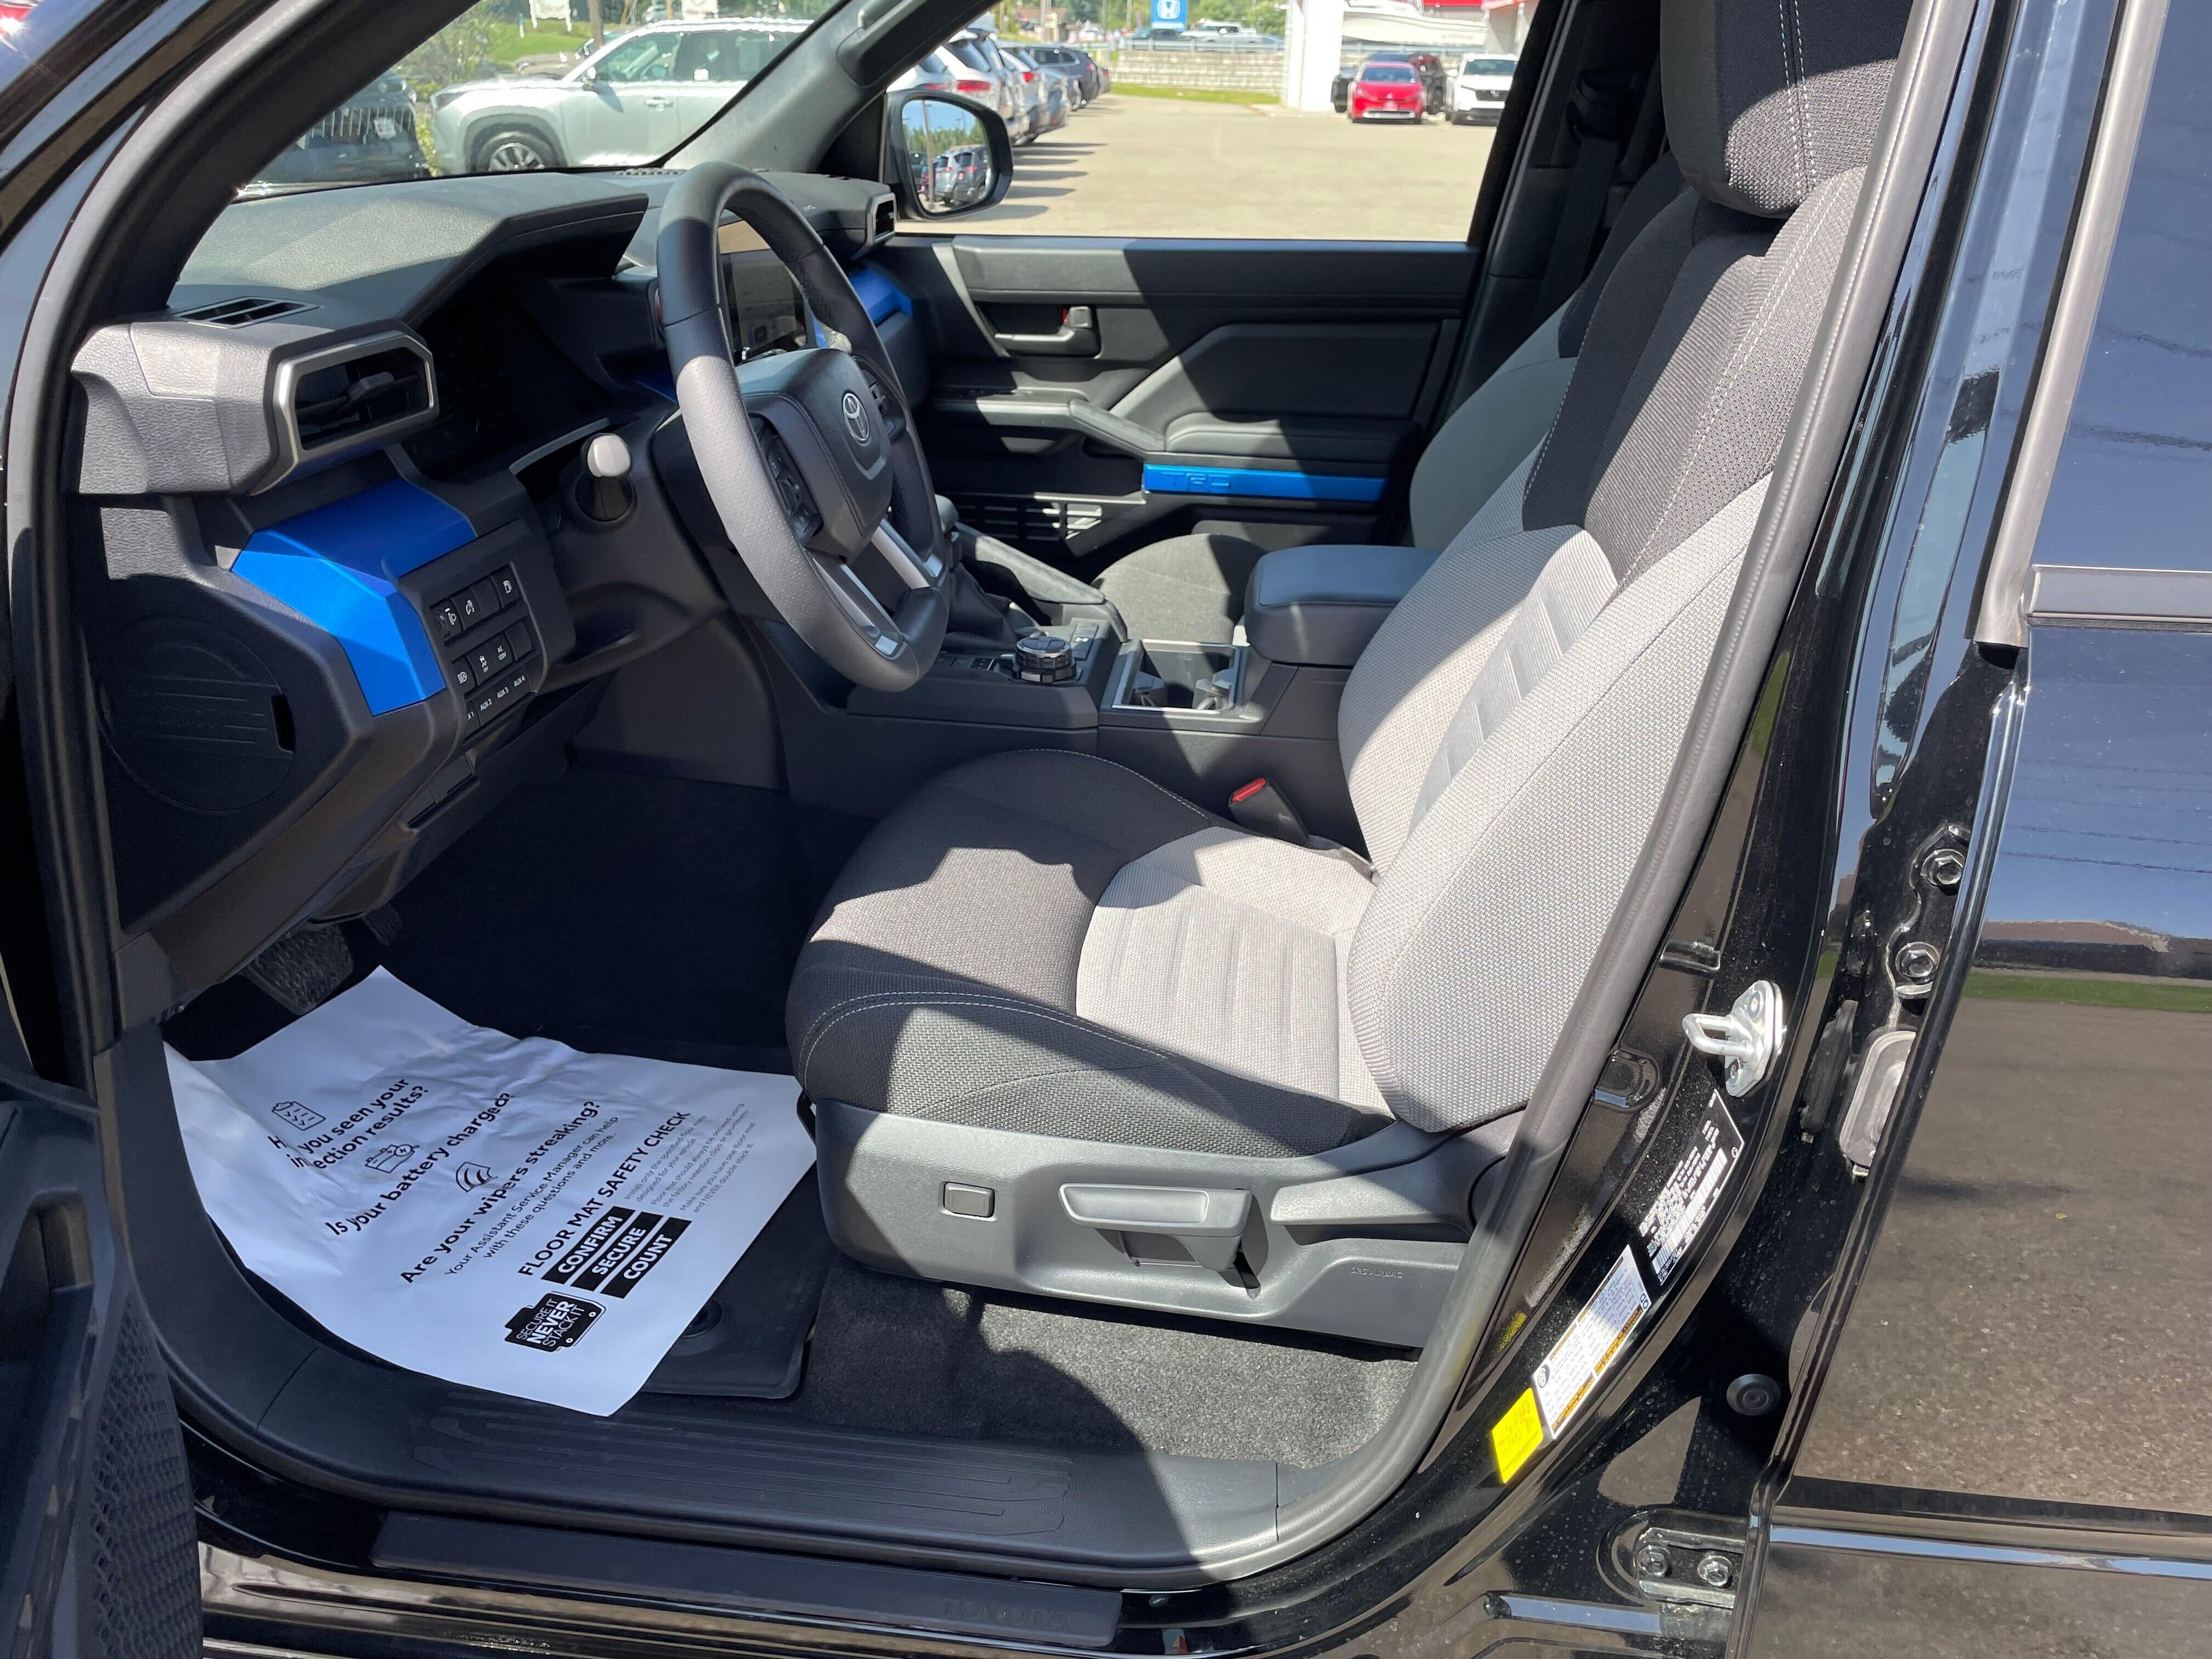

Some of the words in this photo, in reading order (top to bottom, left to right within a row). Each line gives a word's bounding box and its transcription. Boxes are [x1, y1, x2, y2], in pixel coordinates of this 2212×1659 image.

[497, 689, 506, 698] AUX
[514, 677, 522, 687] AUX
[480, 701, 489, 711] AUX
[286, 1135, 369, 1169] inection
[365, 1085, 429, 1136] results?
[297, 1133, 334, 1154] you
[331, 1107, 374, 1136] seen
[371, 1079, 409, 1109] your
[624, 1183, 642, 1200] Install
[641, 1170, 655, 1183] only
[651, 1160, 662, 1170] the
[636, 1177, 662, 1202] designed
[658, 1167, 669, 1177] for
[668, 1156, 680, 1169] your
[662, 1197, 673, 1207] the
[671, 1180, 692, 1198] factory
[690, 1157, 712, 1180] retention
[675, 1163, 693, 1184] should
[693, 1202, 705, 1213] and
[719, 1165, 738, 1184] double
[736, 1149, 750, 1165] stack
[696, 1185, 708, 1196] sure
[707, 1174, 717, 1186] you
[715, 1161, 728, 1175] have
[733, 1135, 746, 1149] floor
[325, 1221, 348, 1235] Is
[346, 1202, 387, 1232] your
[380, 1147, 450, 1201] battery
[400, 1255, 439, 1283] Are
[433, 1218, 476, 1254] your
[473, 1166, 528, 1216] wipers
[525, 1101, 600, 1165] streaking?
[444, 1253, 473, 1276] Your
[470, 1211, 516, 1254] Assistant
[517, 1182, 548, 1213] Service
[543, 1143, 584, 1182] Manager
[583, 1131, 601, 1145] can
[597, 1116, 619, 1133] help
[483, 1237, 509, 1259] with
[507, 1214, 534, 1239] these
[532, 1170, 575, 1213] questions
[573, 1153, 592, 1170] and
[590, 1133, 617, 1154] more.
[518, 1229, 575, 1276] FLOOR
[567, 1198, 603, 1227] MAT
[598, 1147, 649, 1198] SAFETY
[644, 1112, 691, 1147] CHECK
[557, 1215, 623, 1273] CONFIRM
[592, 1227, 647, 1276] SECURE
[624, 1234, 673, 1280] COUNT
[1351, 1267, 1367, 1276] SRS
[1369, 1268, 1403, 1279] AIRBAG
[516, 1308, 552, 1340] SECURE
[546, 1298, 558, 1308] IT
[526, 1300, 575, 1345] NEVER
[543, 1314, 579, 1347] STACK
[569, 1304, 585, 1316] IT
[940, 1597, 1069, 1629] TOYOTA
